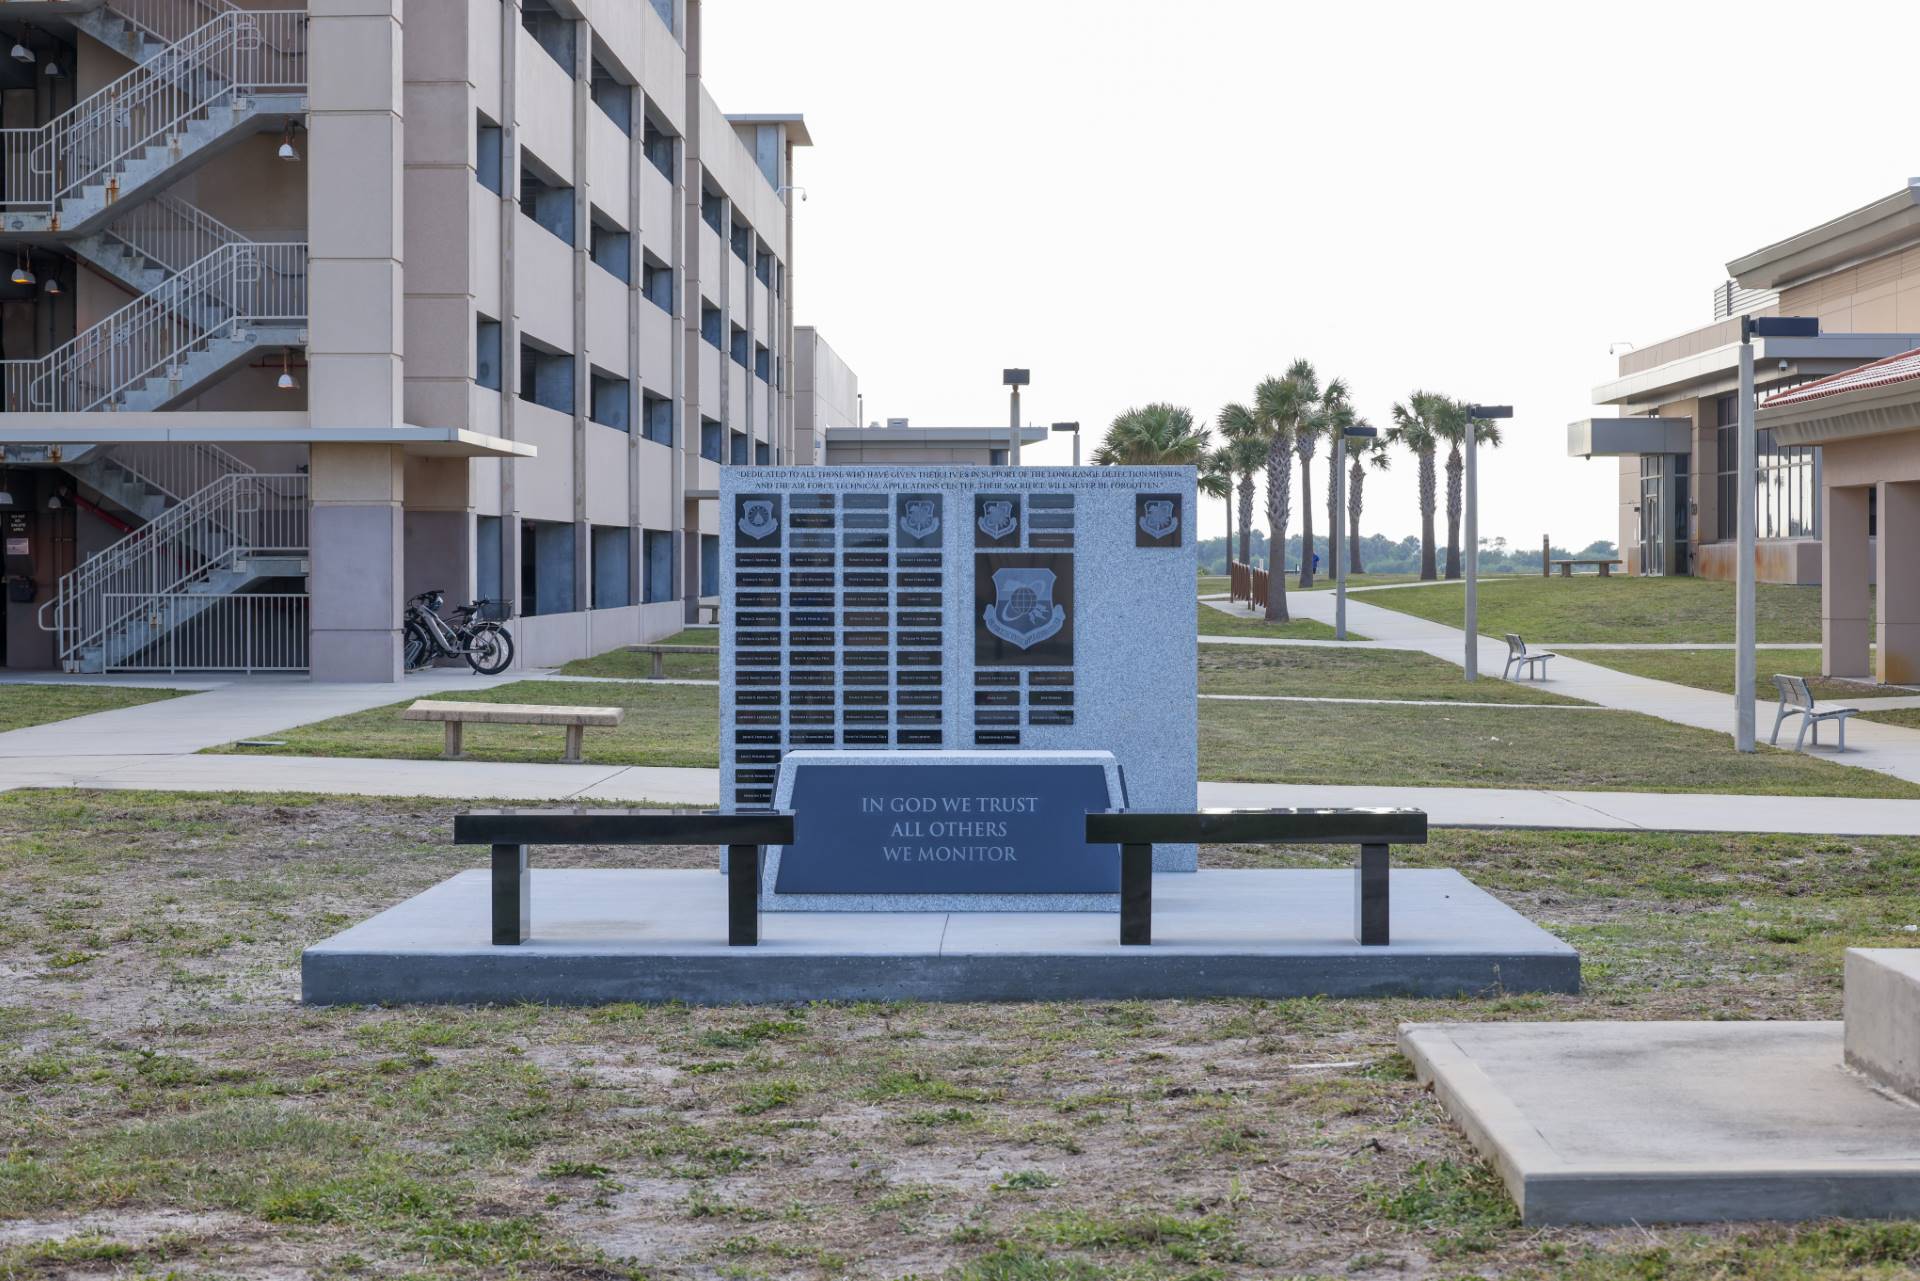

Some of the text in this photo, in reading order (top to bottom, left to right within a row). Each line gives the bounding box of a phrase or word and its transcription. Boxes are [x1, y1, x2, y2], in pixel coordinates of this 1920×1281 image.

[862, 797, 1038, 812] IN GOD WE TRUST
[890, 822, 1008, 837] ALL OTHERS
[882, 846, 1017, 862] WE MONITOR
